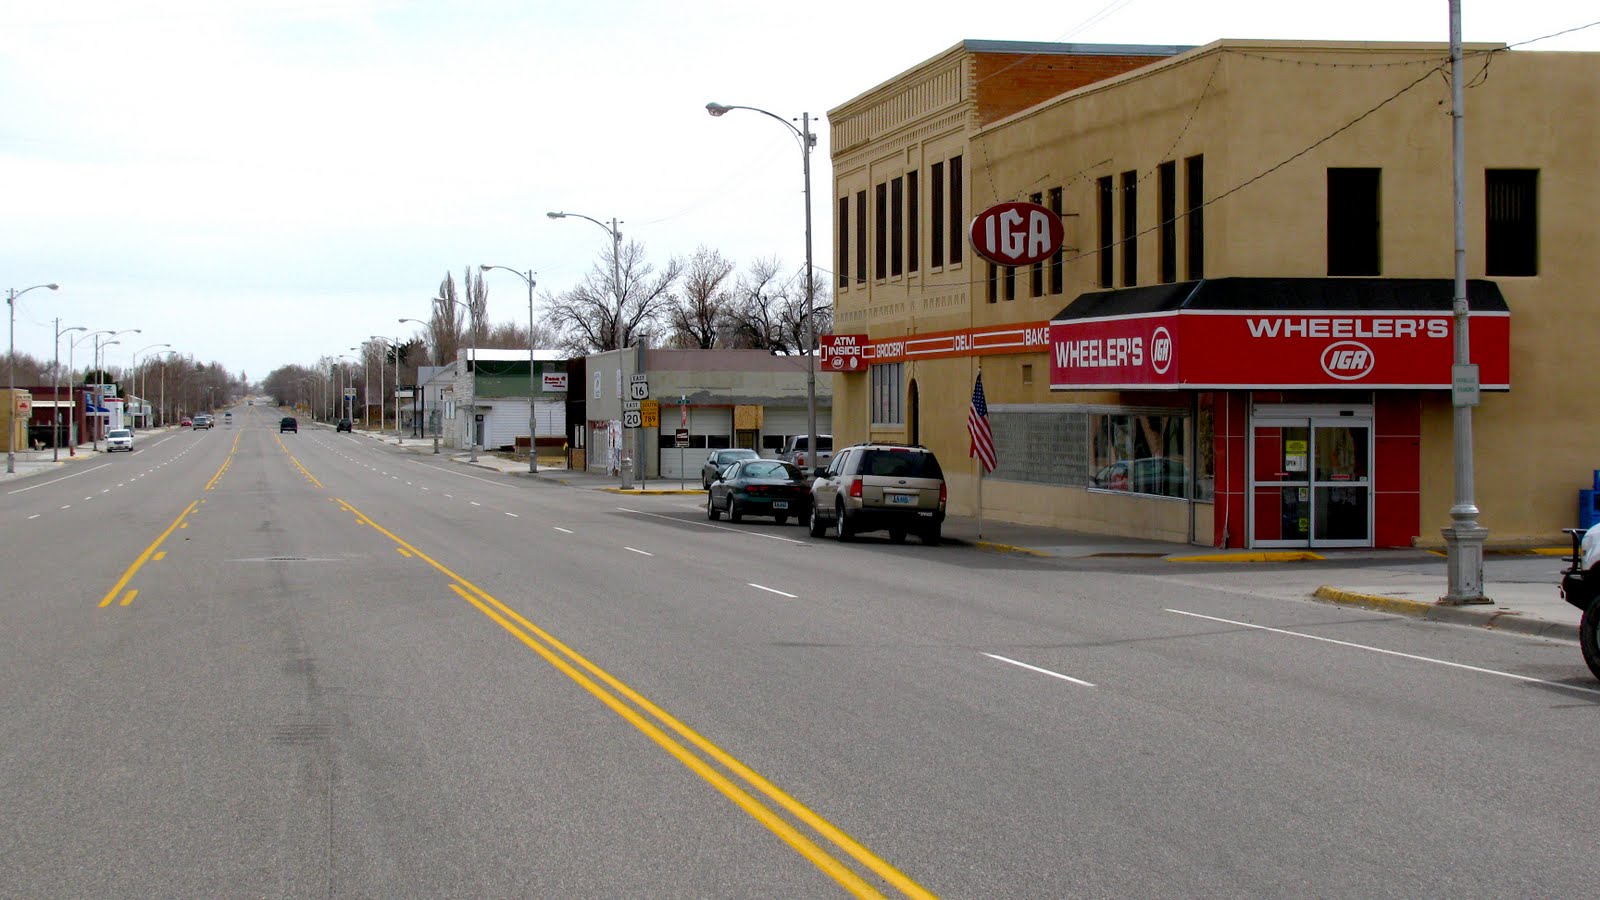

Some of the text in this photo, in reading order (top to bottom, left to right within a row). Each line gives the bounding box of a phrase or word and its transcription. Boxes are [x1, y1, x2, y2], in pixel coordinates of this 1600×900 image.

[985, 208, 1052, 260] IGA
[1246, 318, 1449, 338] WHEELER'S
[833, 336, 856, 345] ATM
[955, 334, 972, 350] DELI
[829, 346, 860, 355] INSIDE
[876, 341, 905, 357] GROCERY
[1055, 336, 1143, 368] WHEELER'S
[1154, 338, 1169, 361] IGA
[1328, 350, 1368, 370] IGA
[635, 386, 645, 396] 16
[626, 414, 638, 424] 20
[644, 415, 656, 423] 789
